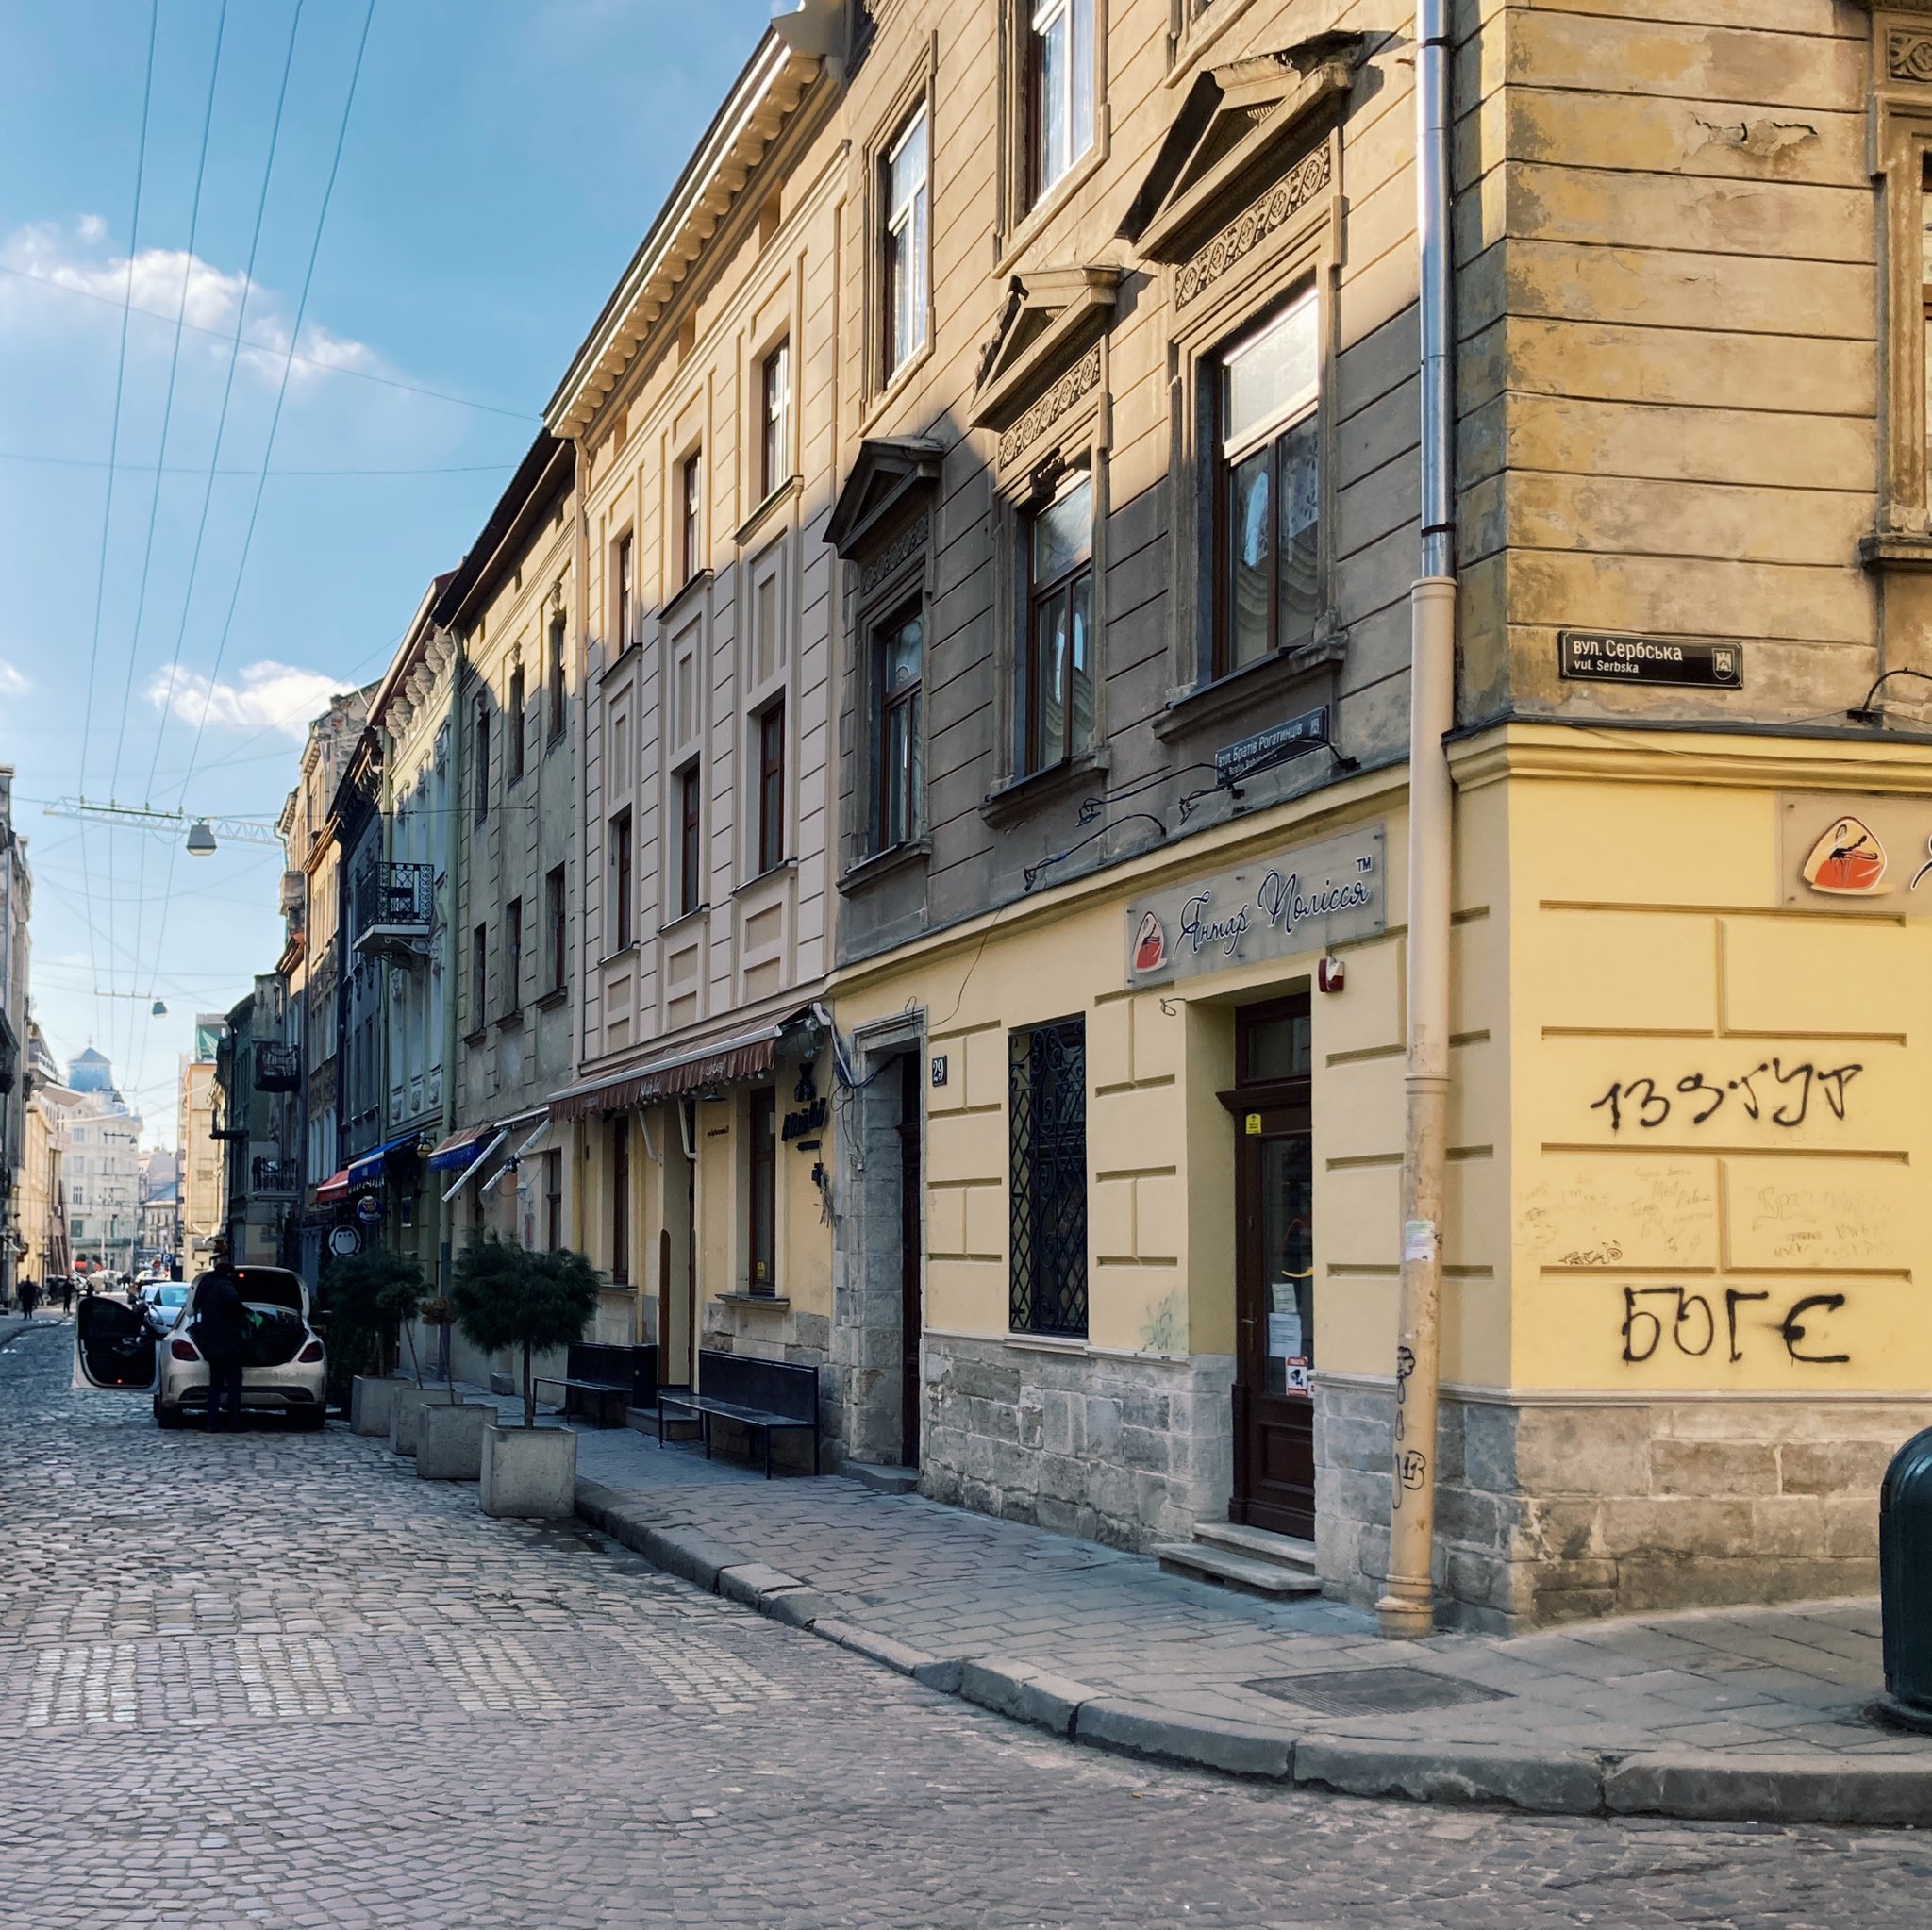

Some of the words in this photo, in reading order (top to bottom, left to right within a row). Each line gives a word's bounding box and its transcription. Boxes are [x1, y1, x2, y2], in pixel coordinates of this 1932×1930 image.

[1574, 640, 1603, 657] вул.
[1606, 639, 1683, 661] Сербська
[1574, 659, 1594, 671] vul.
[1596, 660, 1640, 674] Serbska
[1233, 740, 1257, 762] Братів
[1258, 723, 1303, 751] Рогатинців
[1173, 890, 1253, 960] Янтар
[1257, 868, 1371, 935] Полісся
[932, 1058, 944, 1082] 29
